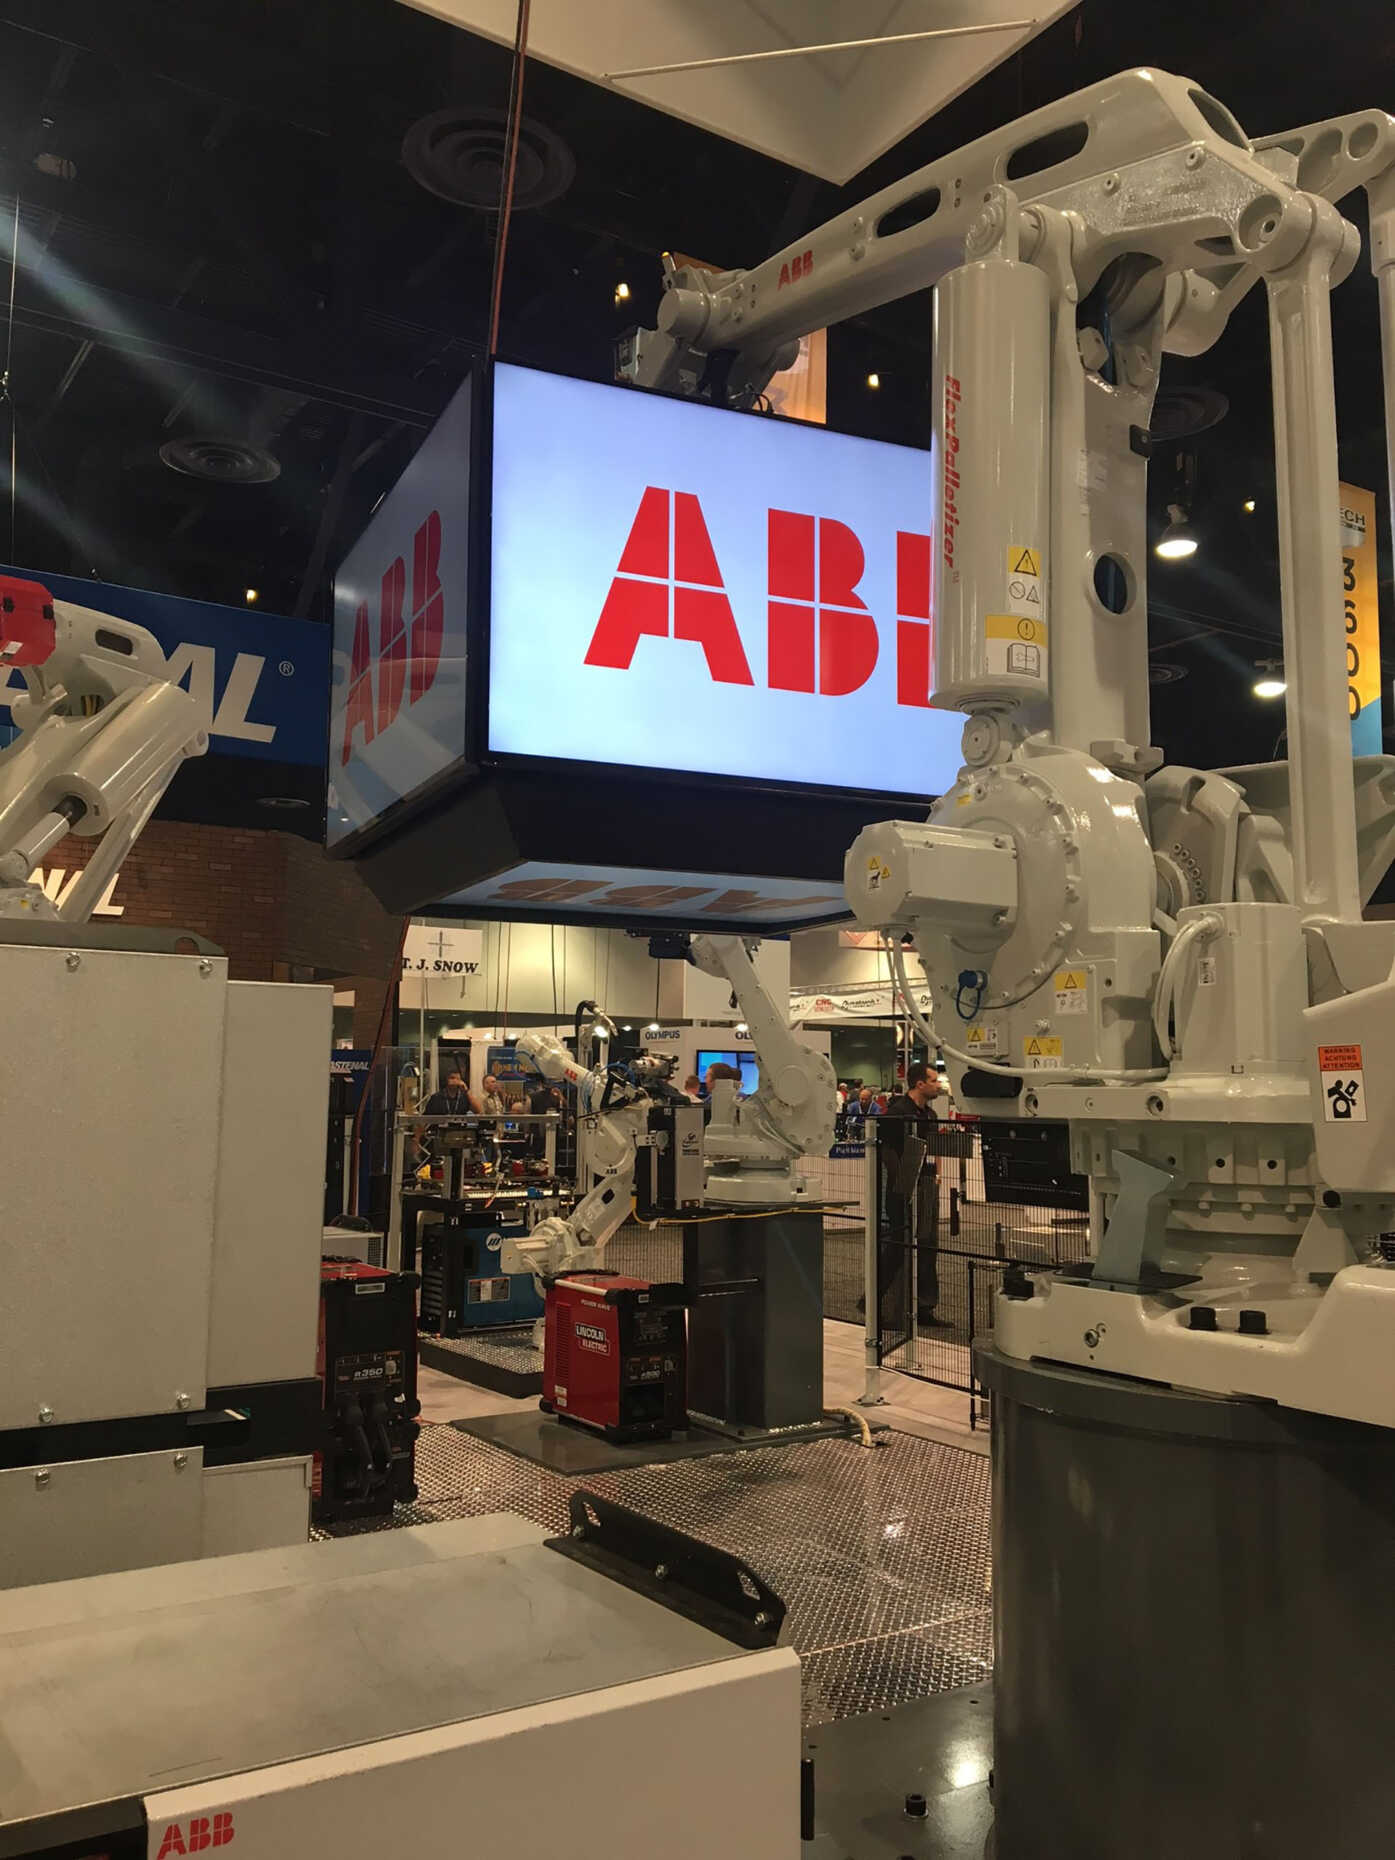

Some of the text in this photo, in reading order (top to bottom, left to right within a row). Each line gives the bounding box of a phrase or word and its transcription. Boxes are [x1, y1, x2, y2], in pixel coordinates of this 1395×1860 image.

[776, 250, 814, 291] ABB
[944, 375, 962, 568] FlexPalletizer
[342, 510, 445, 767] ABB
[433, 960, 479, 974] SNOW
[645, 1031, 681, 1040] OLYMPUS
[576, 1325, 605, 1341] LINCOLN
[582, 1339, 608, 1353] ELECTRIC
[157, 1812, 235, 1860] ABB
